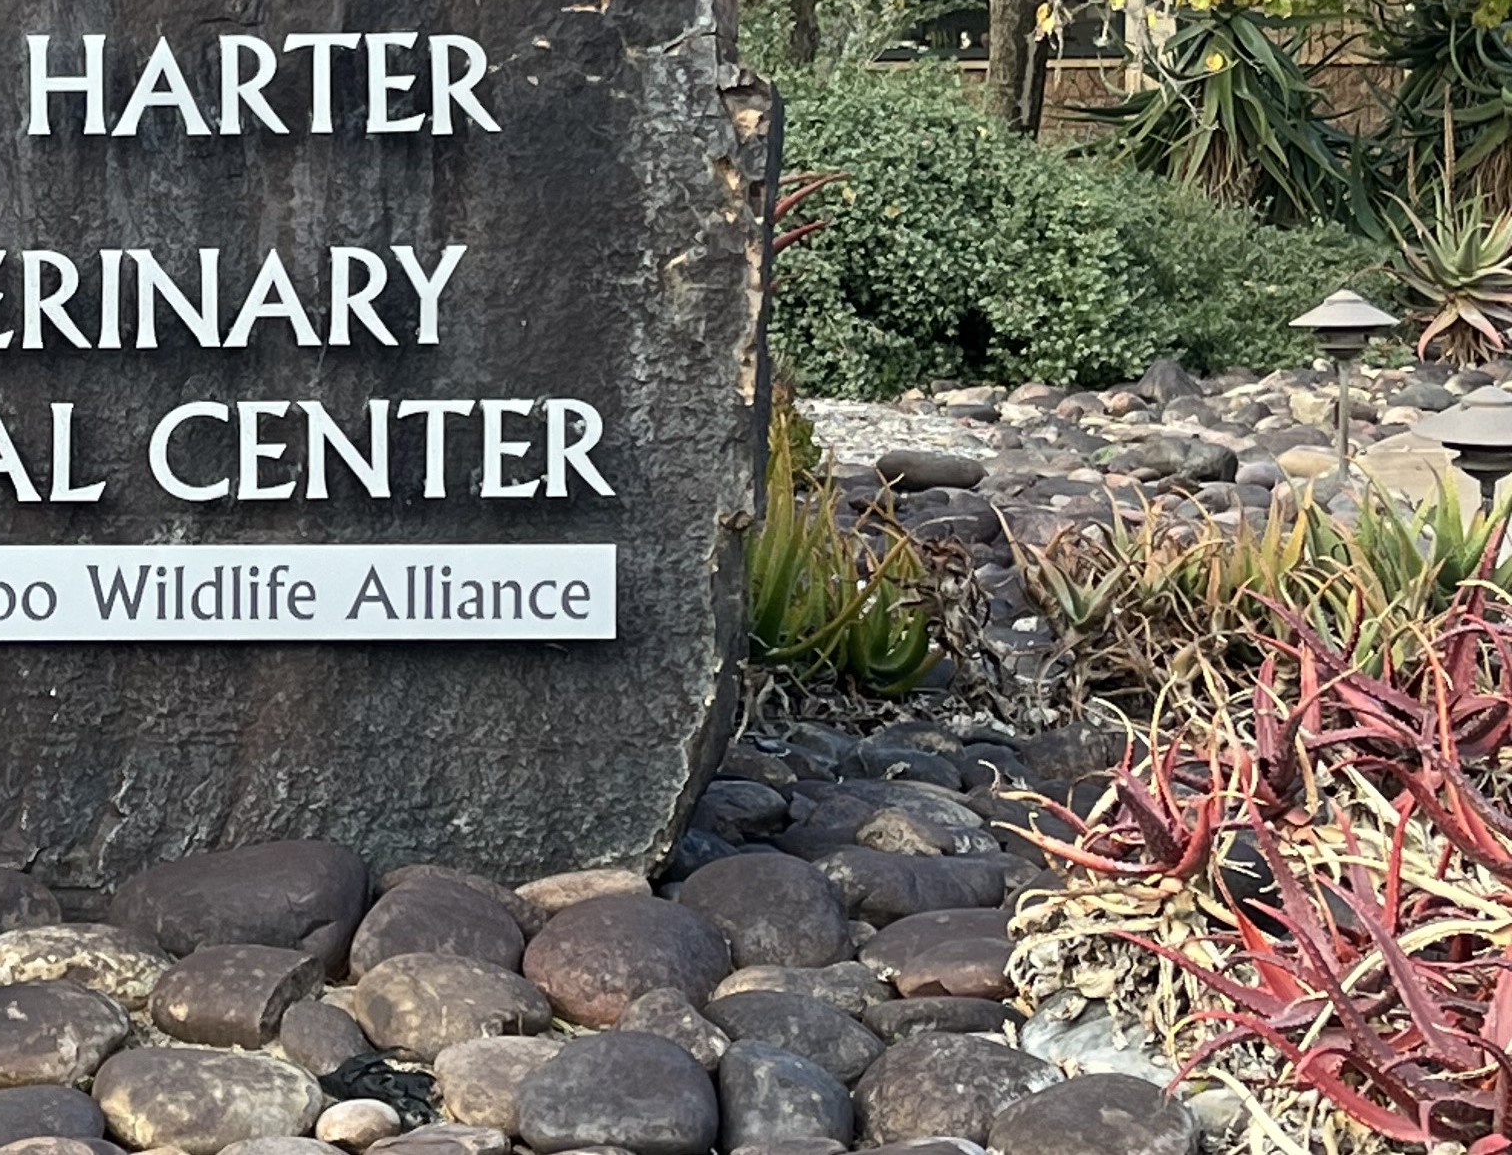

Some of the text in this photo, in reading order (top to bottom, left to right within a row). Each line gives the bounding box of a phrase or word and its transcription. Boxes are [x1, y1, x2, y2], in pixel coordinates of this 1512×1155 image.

[27, 32, 502, 135] HARTER
[150, 399, 616, 501] CENTER
[87, 565, 317, 620] Wildlife
[346, 565, 591, 620] Alliance
